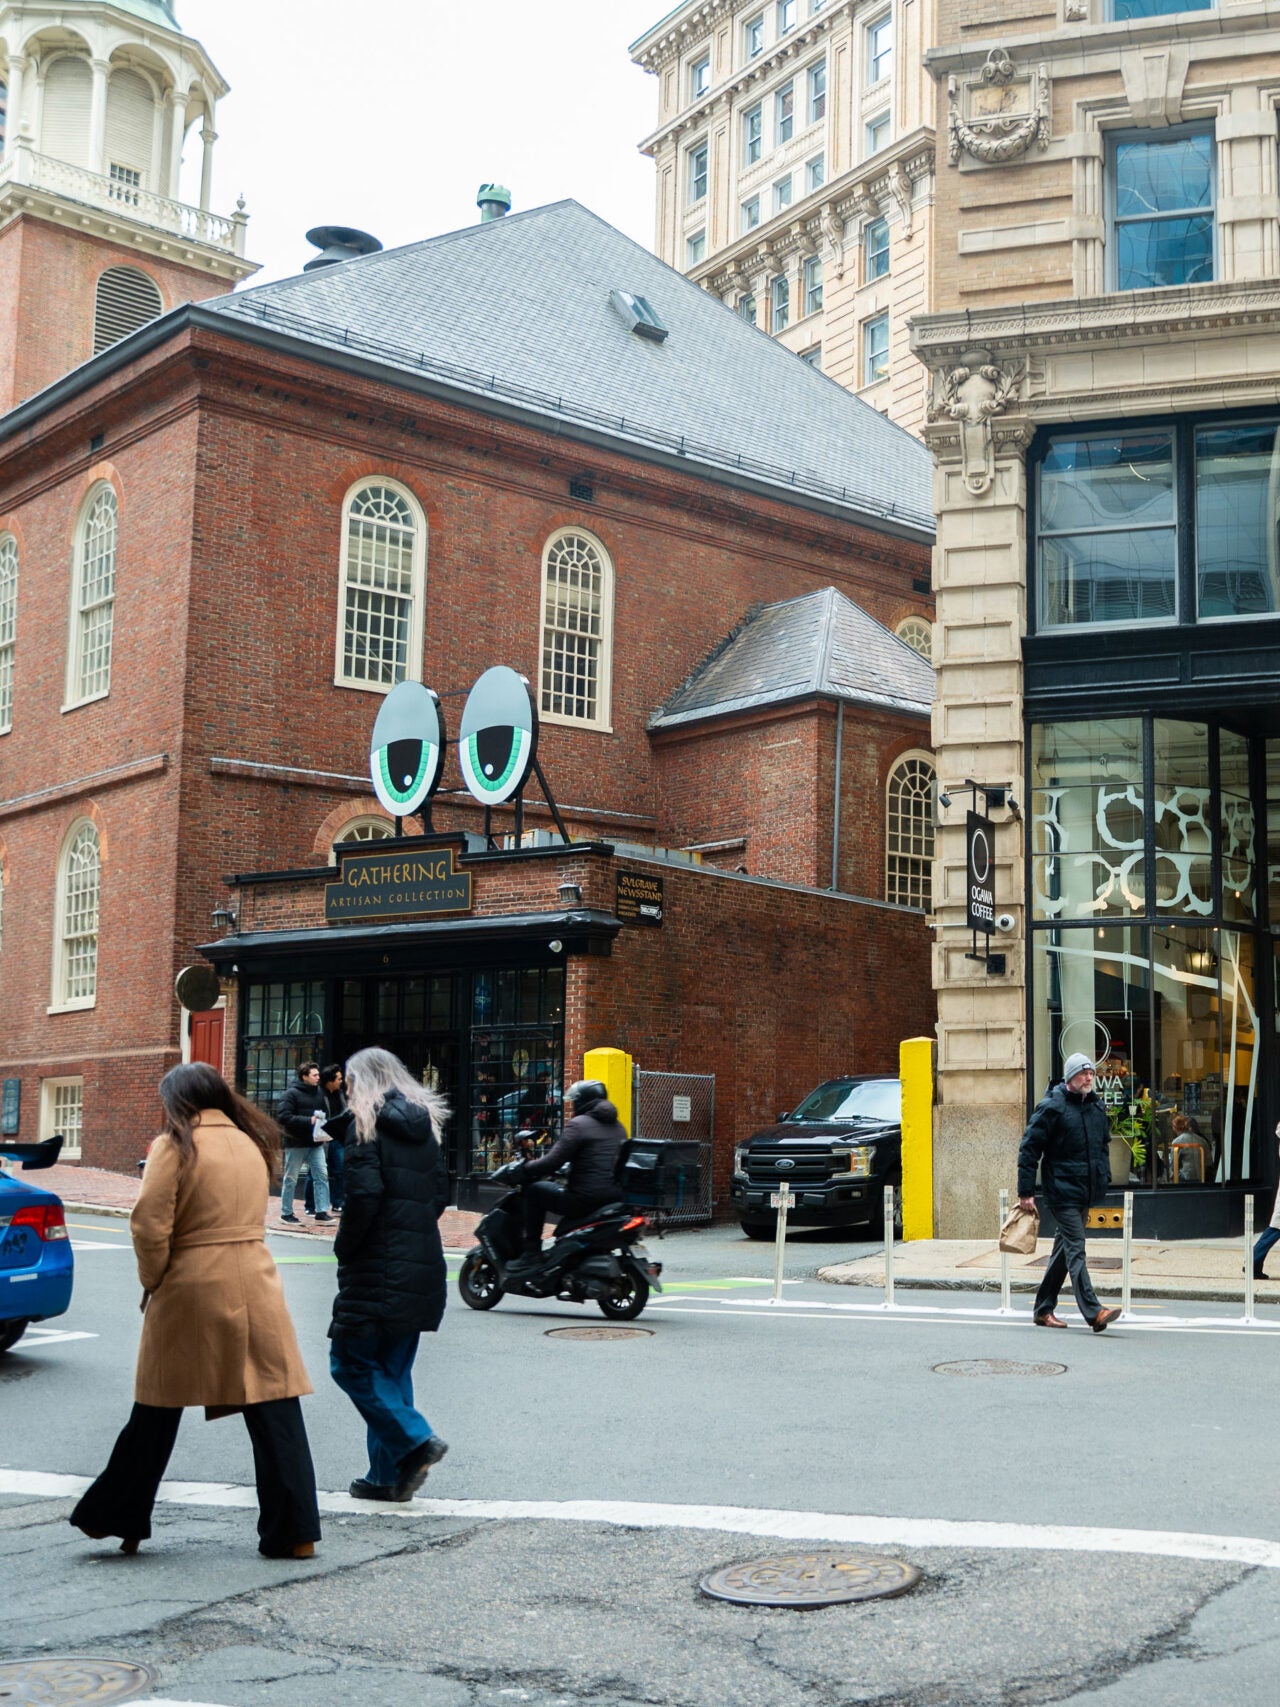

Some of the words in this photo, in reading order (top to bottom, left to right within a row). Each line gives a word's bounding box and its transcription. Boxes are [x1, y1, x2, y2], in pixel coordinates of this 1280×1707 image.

[348, 861, 446, 888] GATHERING
[622, 876, 658, 891] SULGRAVE
[330, 895, 382, 908] ARTISAN
[388, 888, 466, 903] COLLECTION
[617, 885, 662, 902] NEWSSTAND
[971, 885, 993, 906] OGAWA
[971, 901, 993, 920] COFFEE
[383, 953, 389, 963] 6
